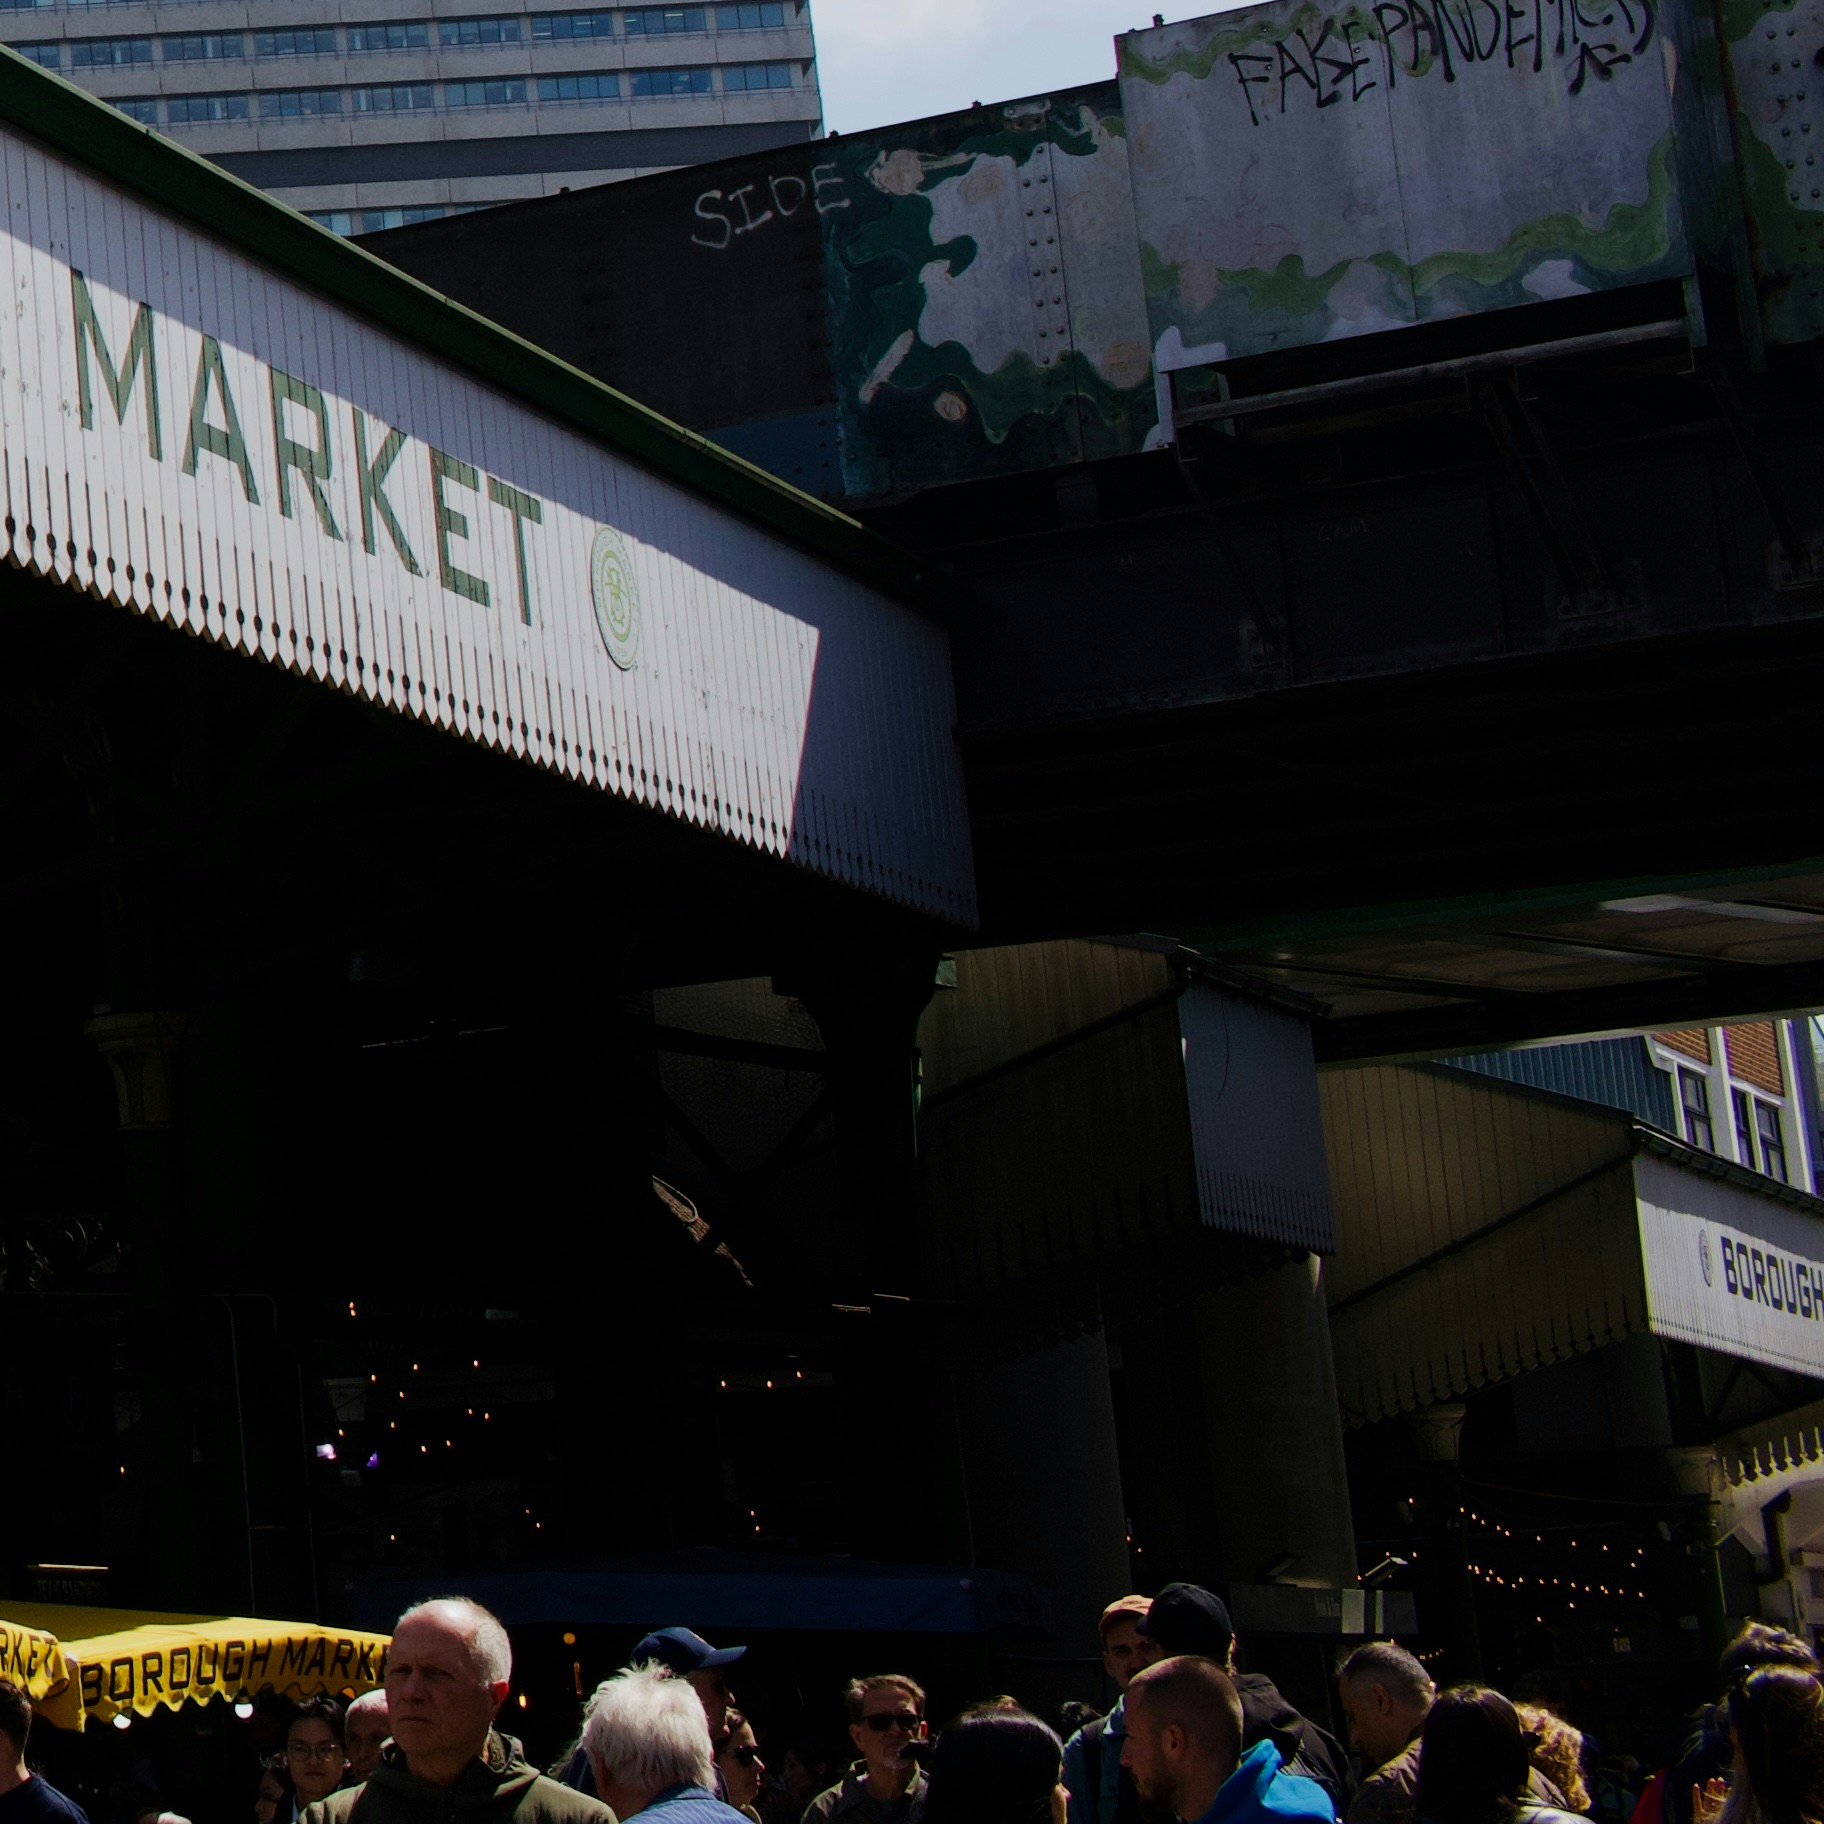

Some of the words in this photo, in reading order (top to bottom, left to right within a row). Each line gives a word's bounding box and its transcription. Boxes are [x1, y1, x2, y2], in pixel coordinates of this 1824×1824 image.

[1228, 19, 1376, 125] FAKE
[690, 162, 851, 249] SIDE
[70, 267, 541, 627] MARKET
[1719, 1236, 1824, 1322] BOROUGH
[80, 1637, 272, 1707] BOROUGH
